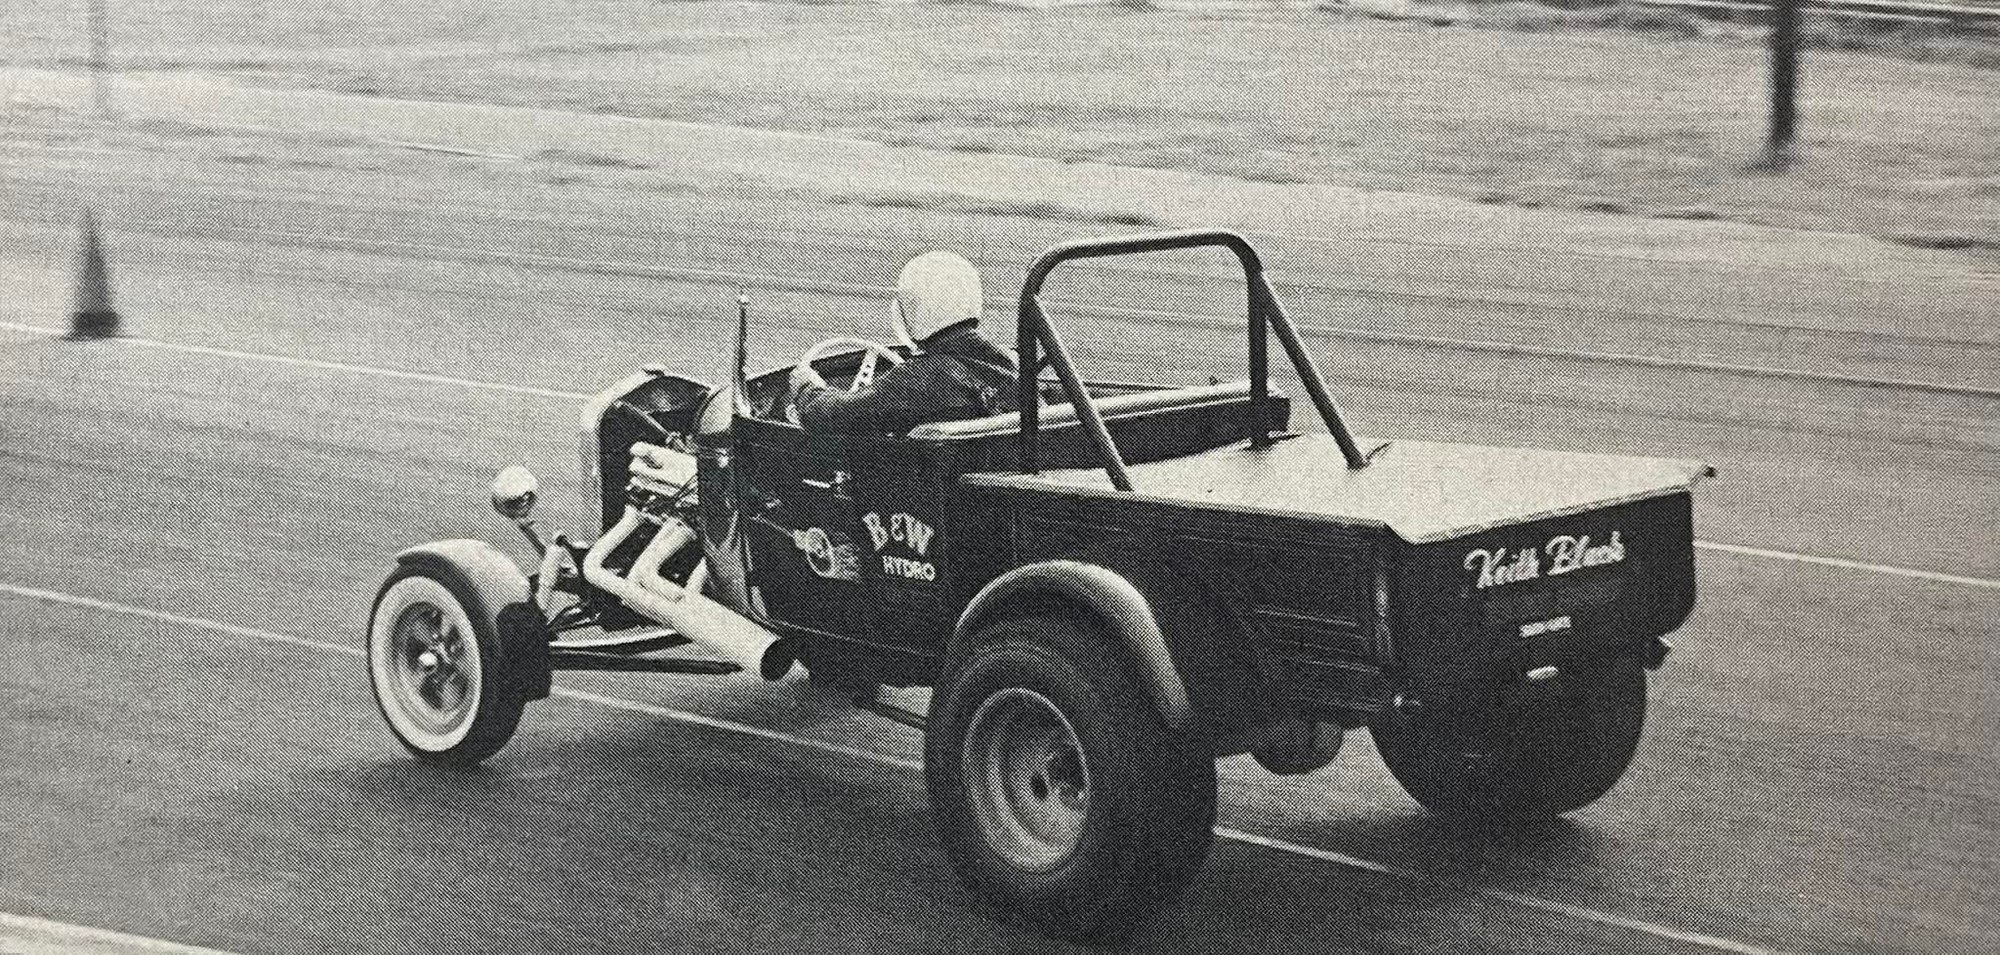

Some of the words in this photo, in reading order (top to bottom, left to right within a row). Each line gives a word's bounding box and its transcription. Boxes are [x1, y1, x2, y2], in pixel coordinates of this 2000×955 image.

[882, 555, 936, 582] HYDRO
[1463, 547, 1540, 589] Keith
[1545, 530, 1626, 577] Black
